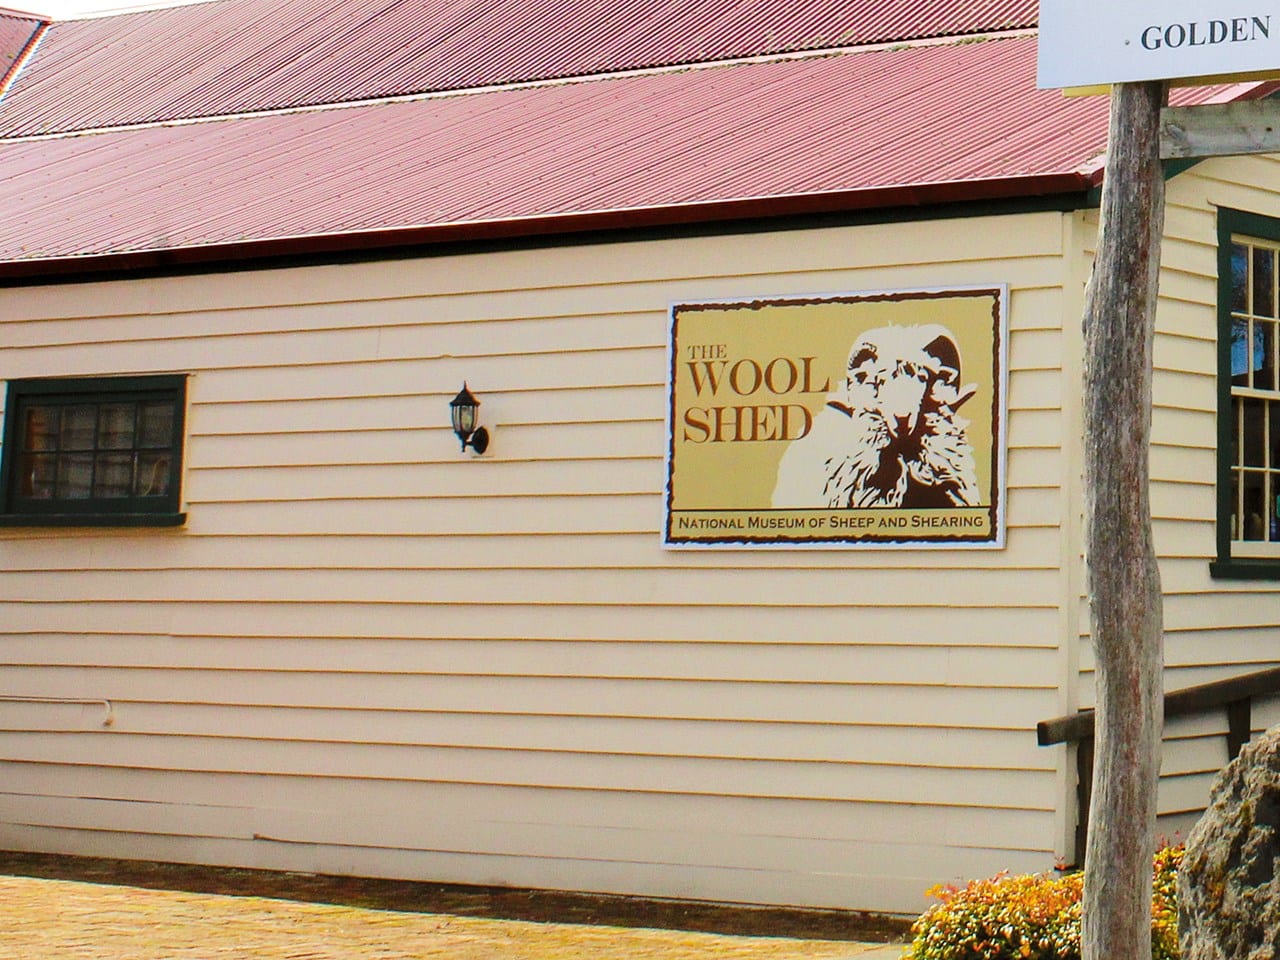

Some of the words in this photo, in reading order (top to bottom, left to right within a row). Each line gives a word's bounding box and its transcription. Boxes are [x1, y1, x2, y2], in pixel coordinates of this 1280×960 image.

[1141, 15, 1271, 51] GOLDEN
[687, 344, 727, 360] THE
[685, 356, 831, 398] WOOL
[683, 404, 813, 444] SHED
[679, 517, 745, 530] NATIONAL
[748, 517, 805, 529] MUSEUM
[808, 517, 827, 529] OF
[830, 516, 875, 529] SHEEP
[878, 517, 907, 529] AND
[911, 515, 984, 528] SHEARING
